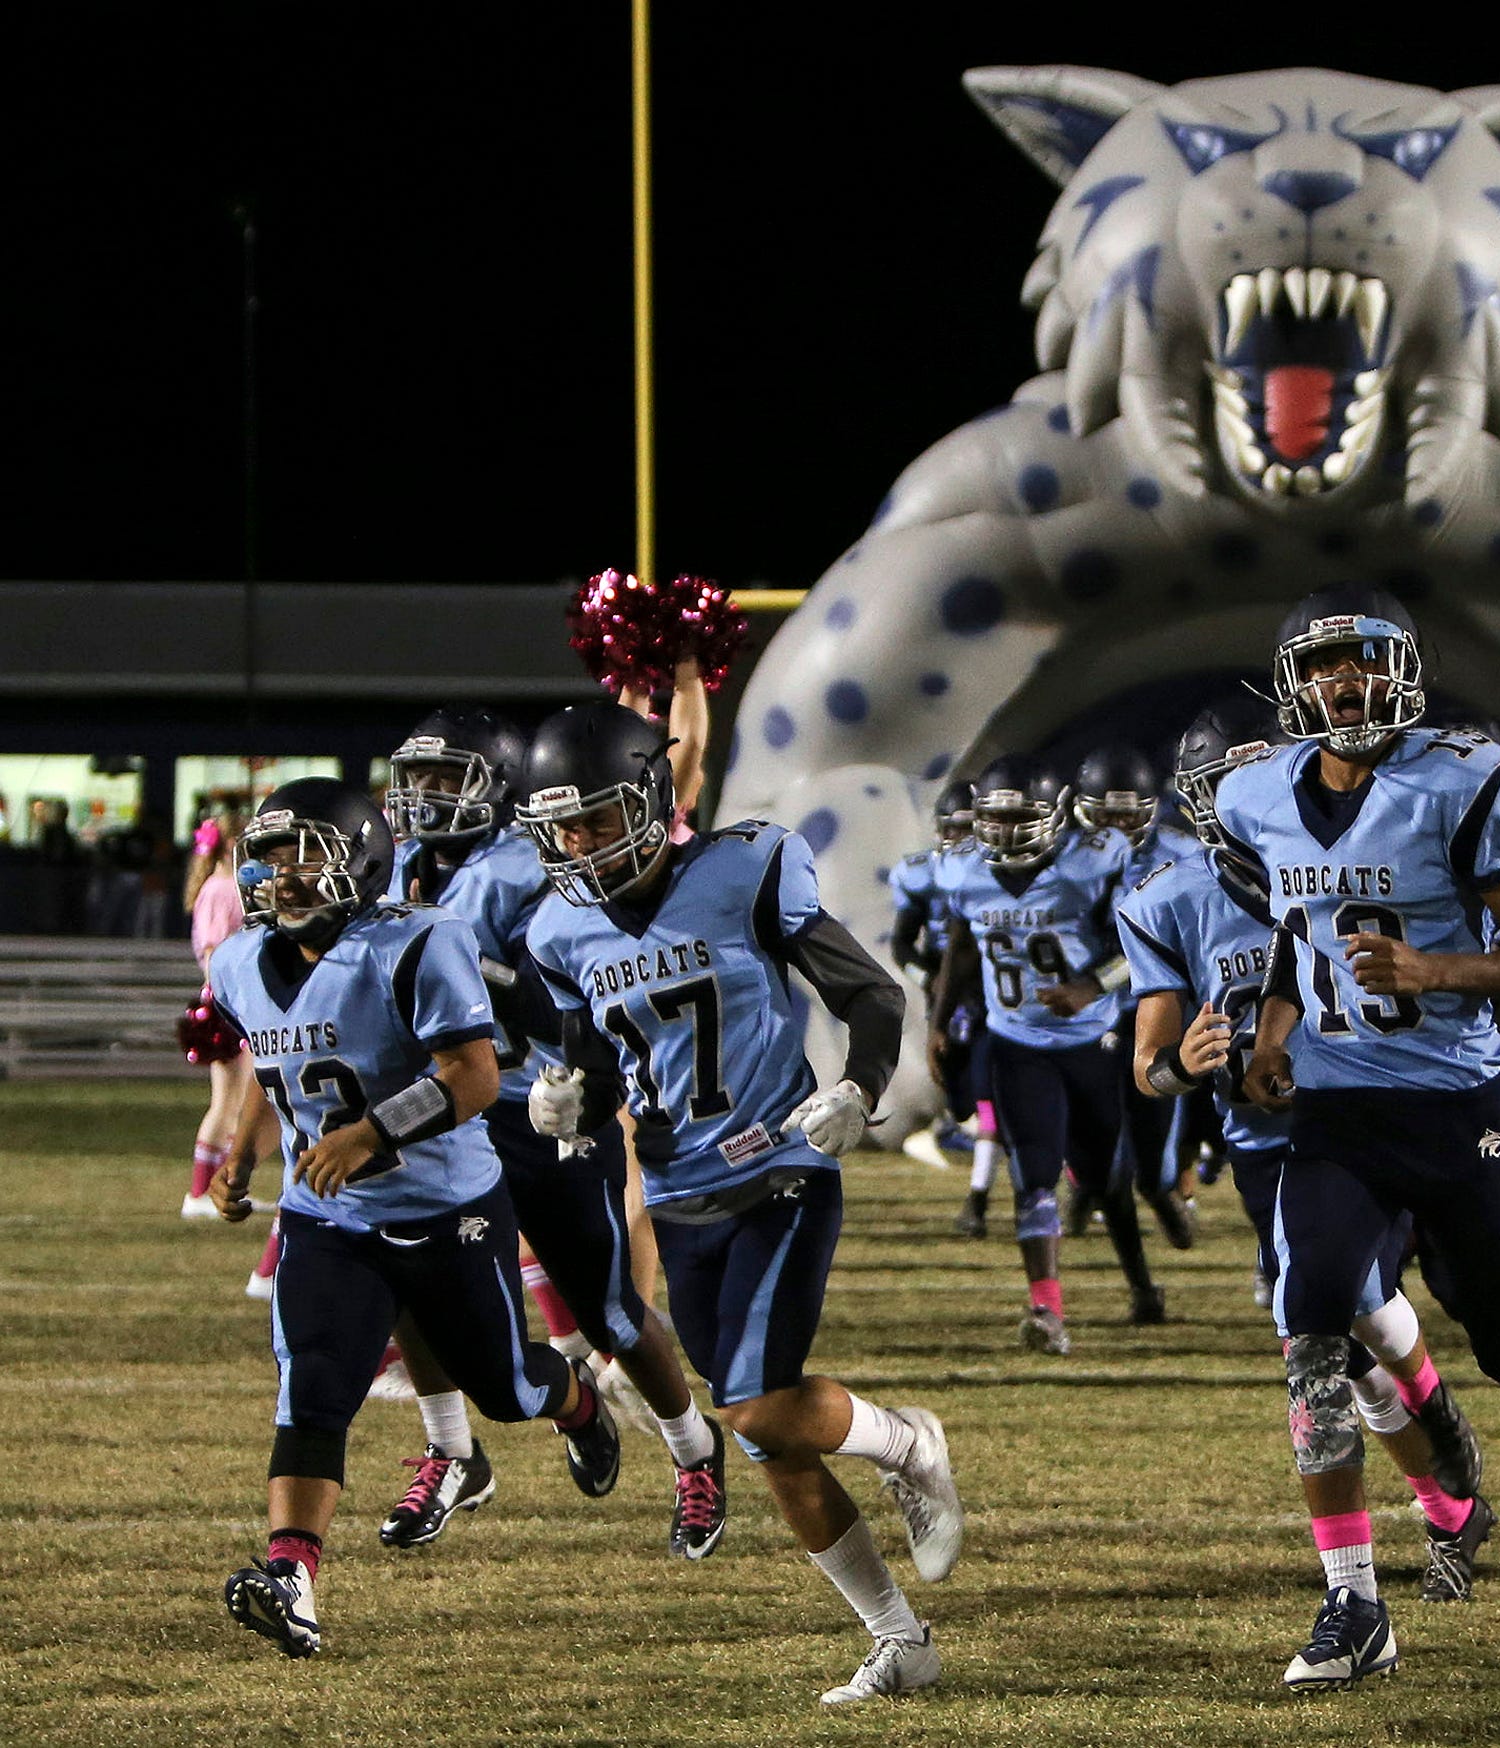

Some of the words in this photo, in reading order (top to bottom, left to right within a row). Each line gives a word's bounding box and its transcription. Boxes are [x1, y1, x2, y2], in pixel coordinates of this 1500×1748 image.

[1322, 618, 1355, 628] Riddell
[1231, 743, 1266, 757] Riddell
[1278, 865, 1393, 897] BOBCATS
[592, 938, 713, 999] BOBCATS
[983, 929, 1069, 1012] 69
[1282, 900, 1425, 1037] 13
[250, 1021, 339, 1058] BOBCATS
[602, 970, 737, 1129] 17
[253, 1055, 409, 1188] 72
